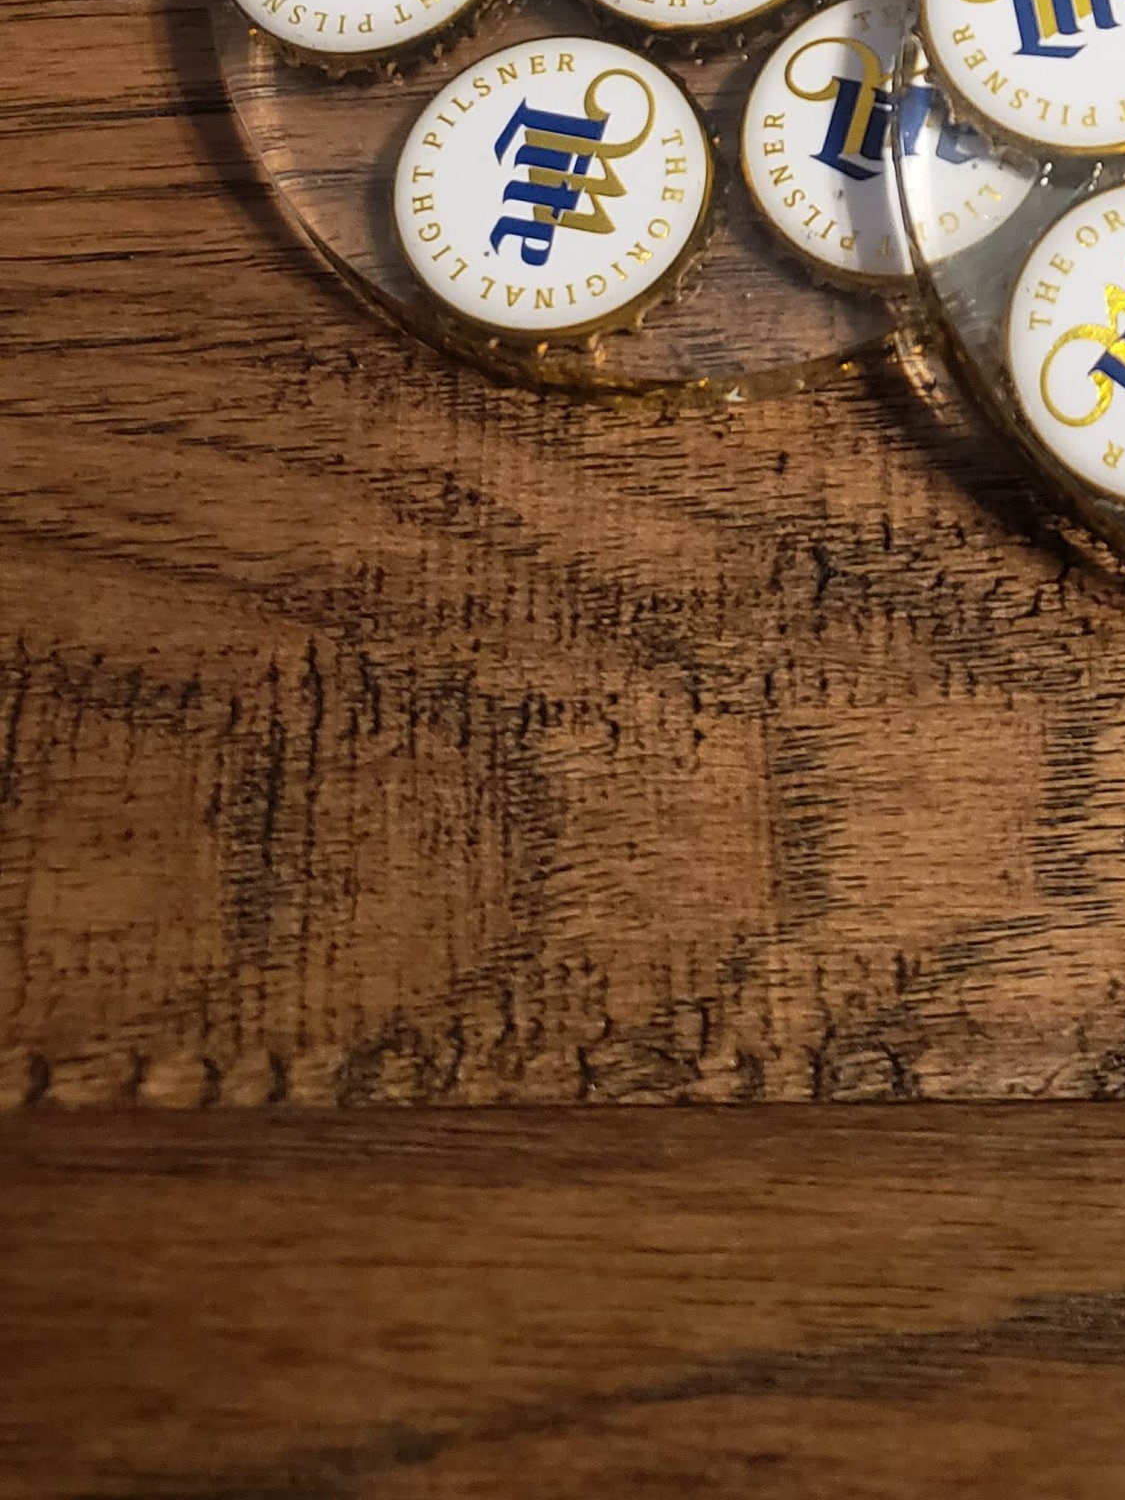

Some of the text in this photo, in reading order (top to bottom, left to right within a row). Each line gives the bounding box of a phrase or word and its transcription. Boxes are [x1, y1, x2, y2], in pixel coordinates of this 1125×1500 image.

[947, 24, 1099, 129] PILSNER
[409, 49, 689, 311] THE ORIGINAL LIGHT PILSNER
[1026, 253, 1074, 330] THE
